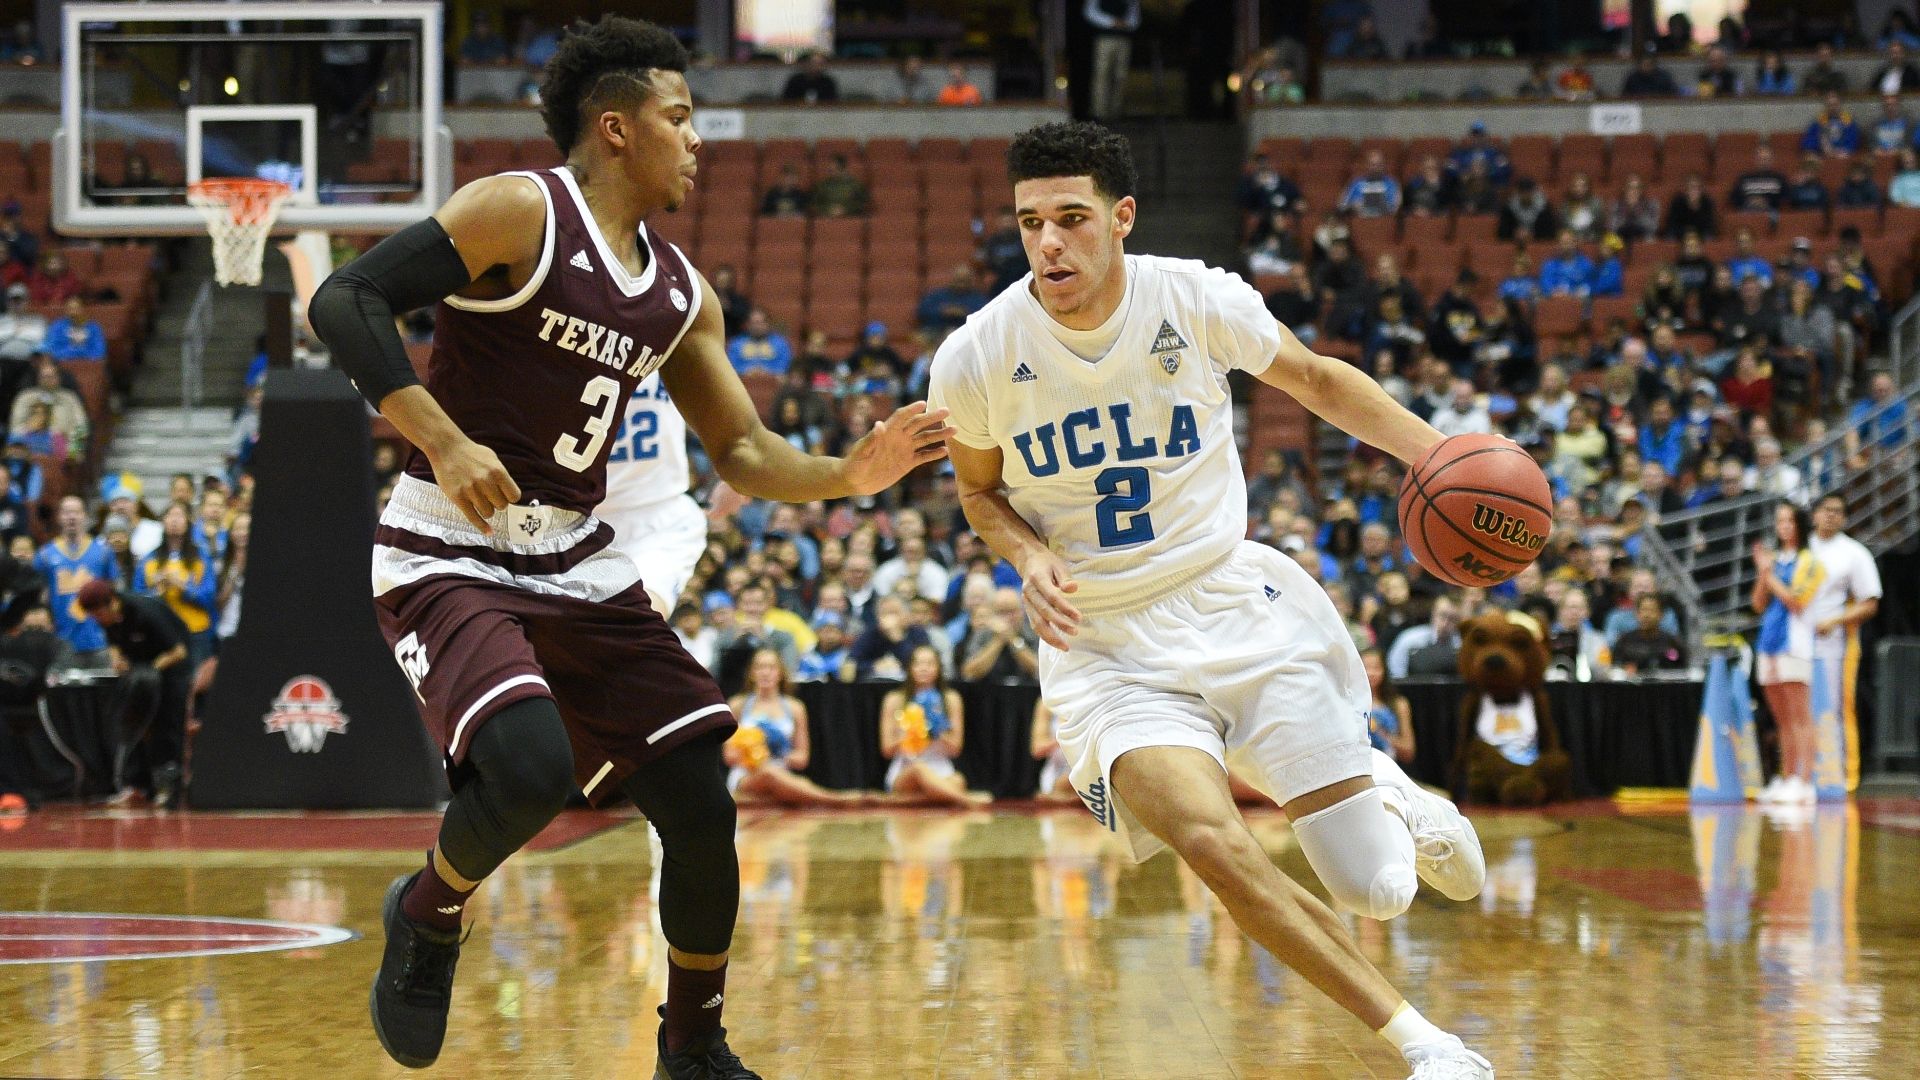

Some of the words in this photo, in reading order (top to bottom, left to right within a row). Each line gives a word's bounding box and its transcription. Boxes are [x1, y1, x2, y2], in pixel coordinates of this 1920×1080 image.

[538, 308, 634, 370] TEXAS
[1155, 335, 1179, 349] JAW
[1011, 373, 1038, 383] adidas
[553, 375, 621, 473] 3
[1013, 403, 1201, 477] UCLA
[1094, 466, 1155, 547] 2
